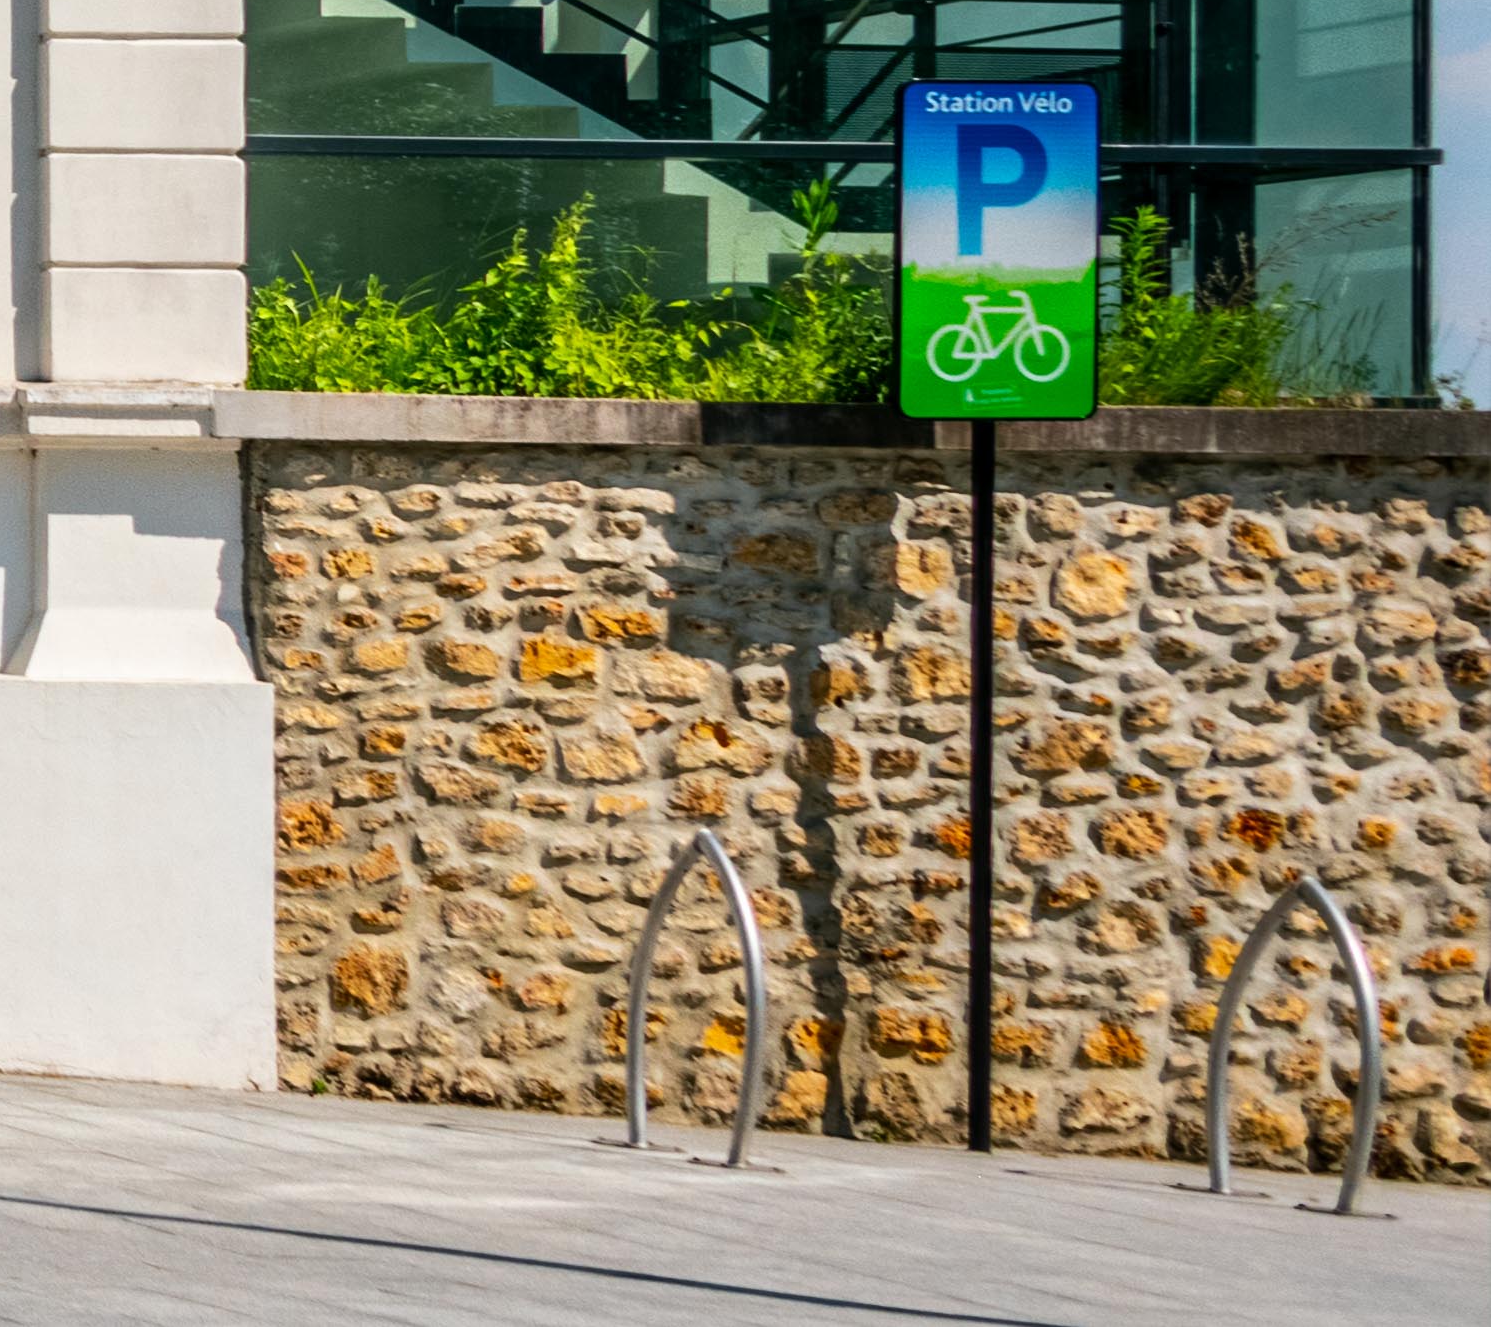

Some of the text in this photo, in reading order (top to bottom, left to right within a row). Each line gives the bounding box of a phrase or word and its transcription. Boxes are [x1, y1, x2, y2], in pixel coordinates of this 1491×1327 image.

[924, 91, 1073, 114] Station Vélo
[956, 123, 1048, 256] P
